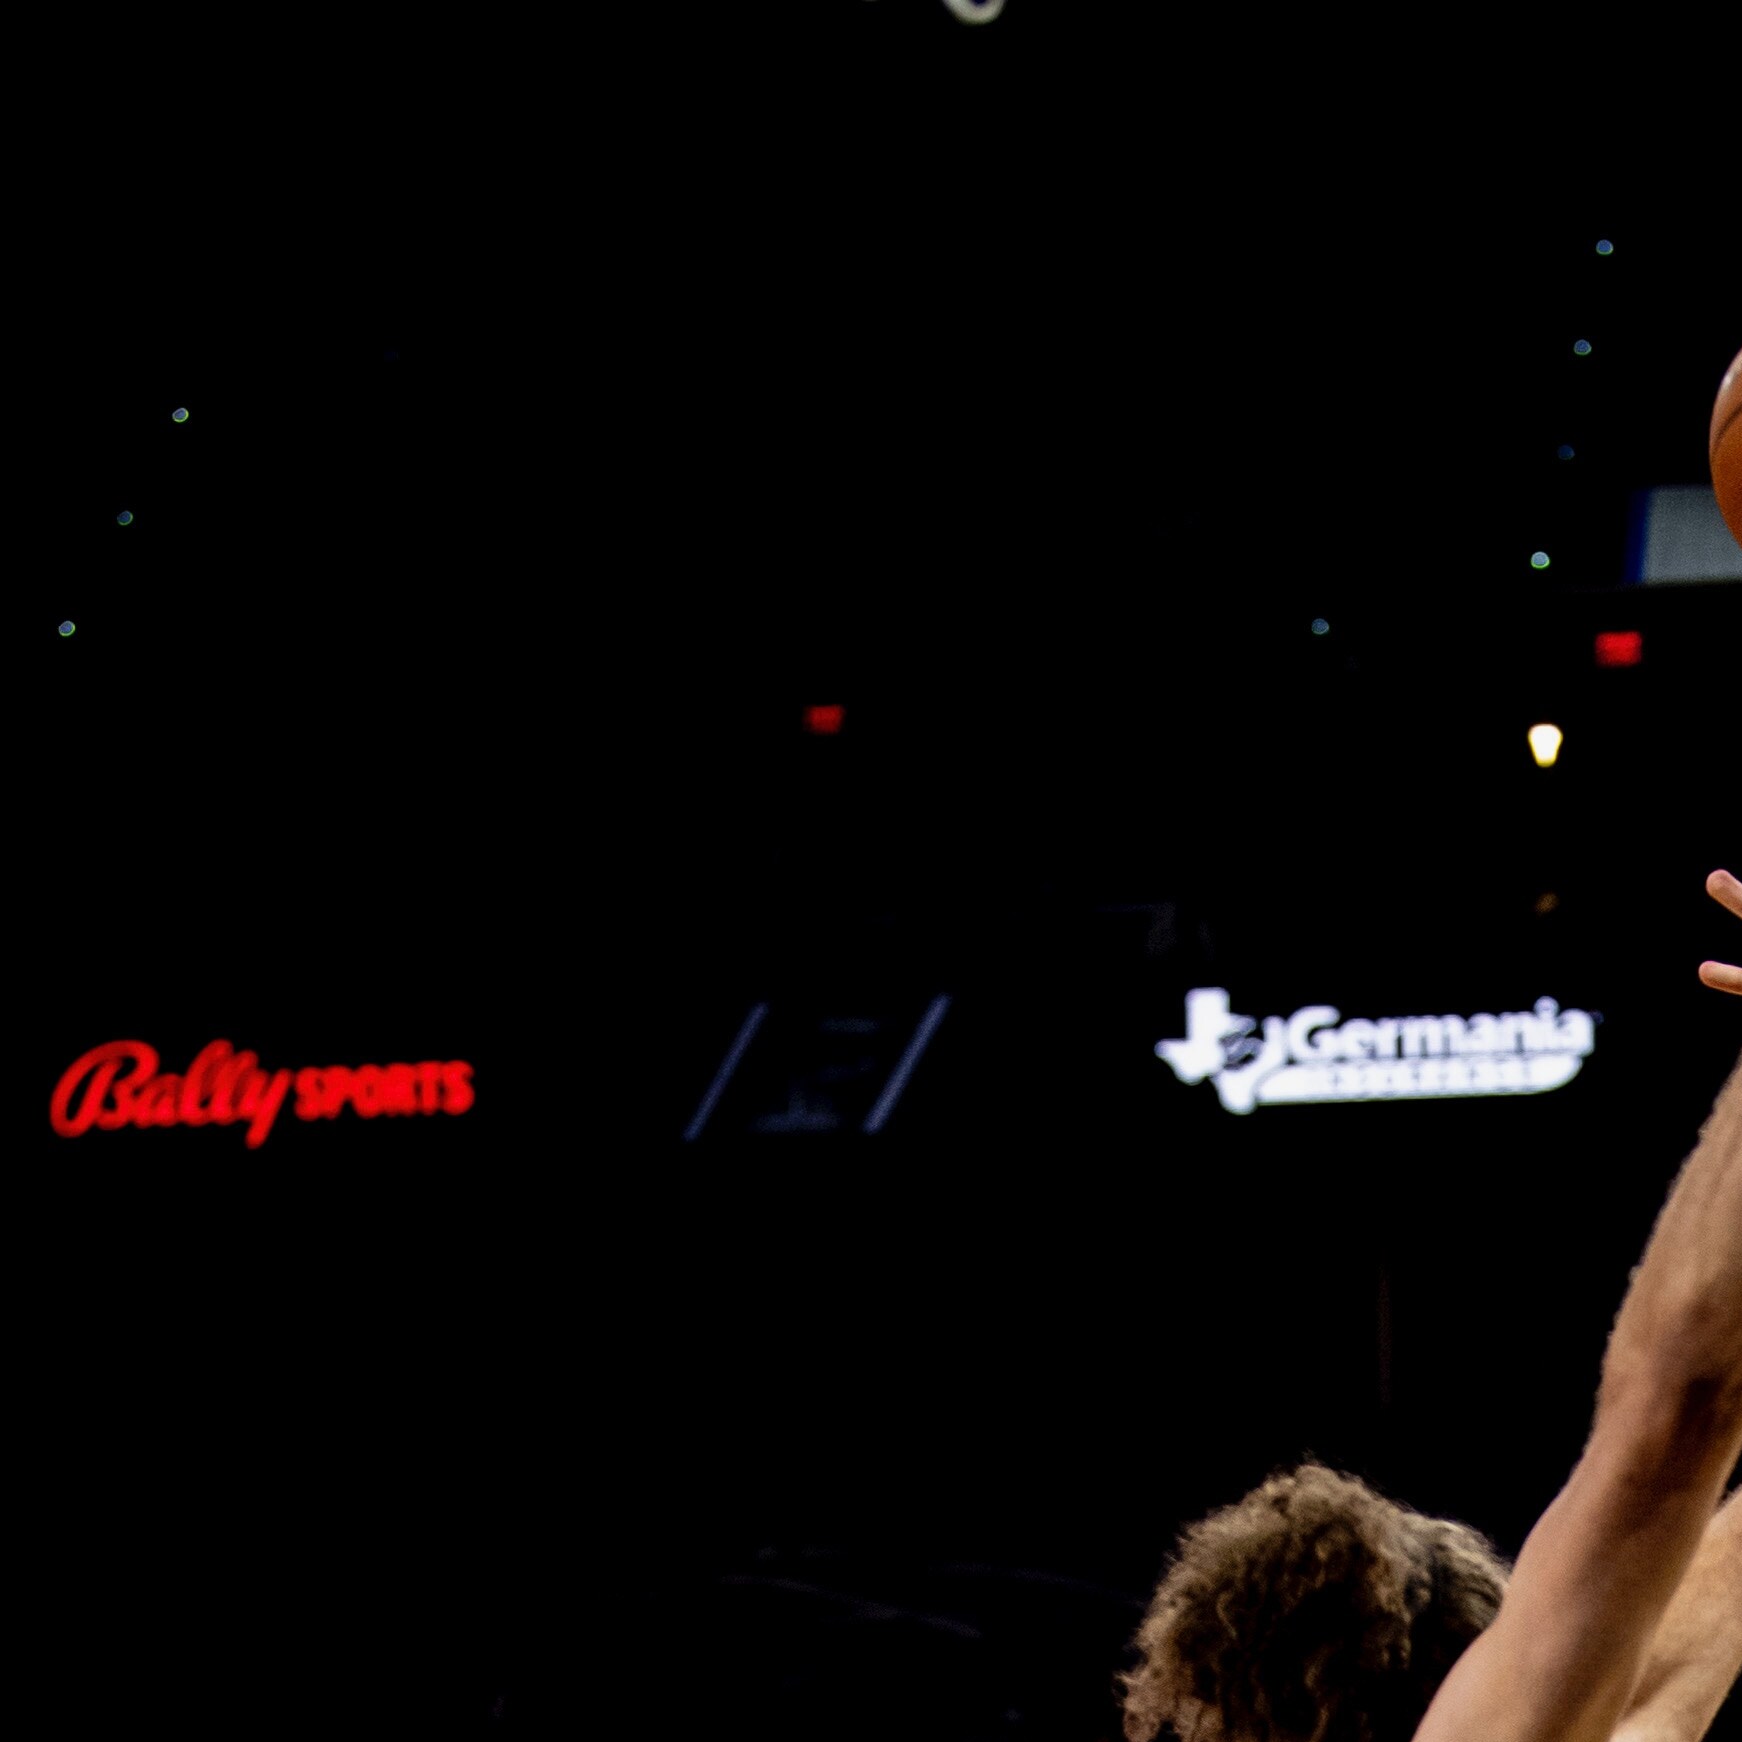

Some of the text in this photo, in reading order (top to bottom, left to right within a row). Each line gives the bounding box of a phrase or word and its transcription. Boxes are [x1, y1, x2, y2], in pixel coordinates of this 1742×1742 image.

[1289, 997, 1595, 1062] Germania
[50, 1039, 475, 1150] Bally SPORTS
